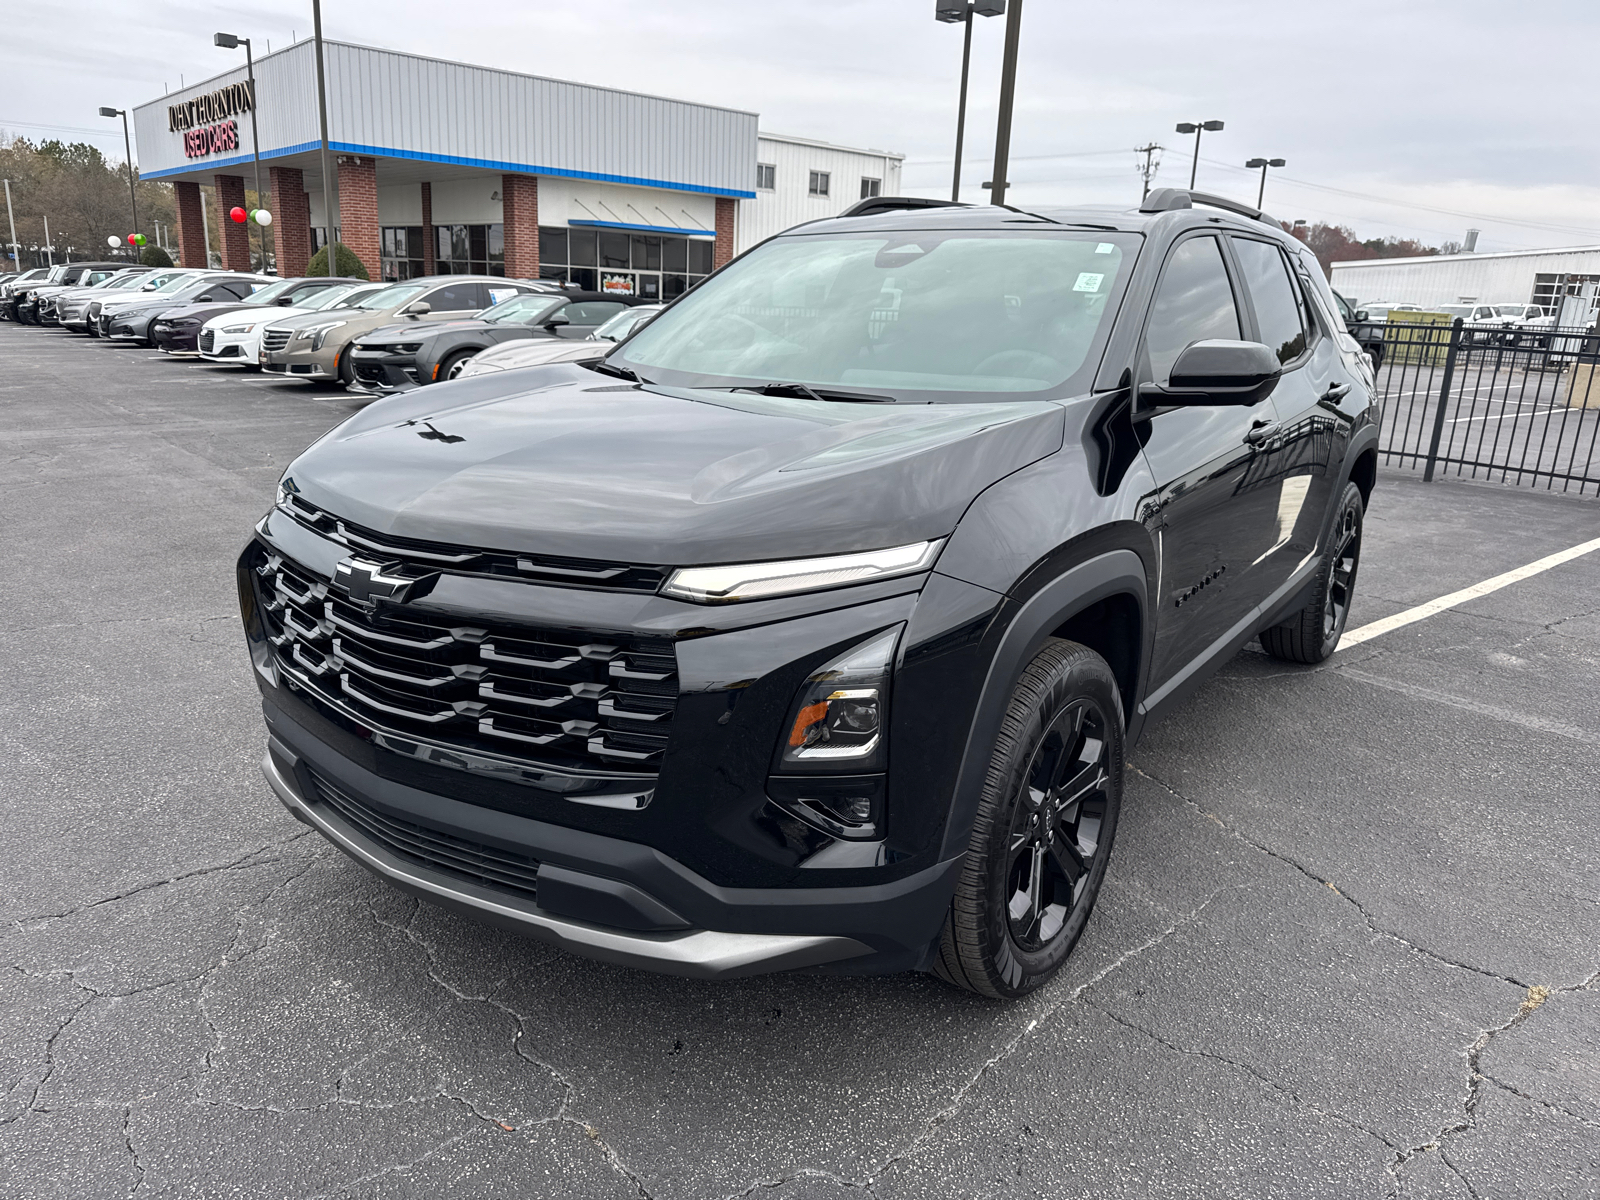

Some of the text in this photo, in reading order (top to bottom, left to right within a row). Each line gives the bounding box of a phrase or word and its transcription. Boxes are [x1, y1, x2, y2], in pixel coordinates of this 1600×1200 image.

[167, 79, 255, 132] JOHN THORNTON
[183, 120, 239, 158] USED CARS
